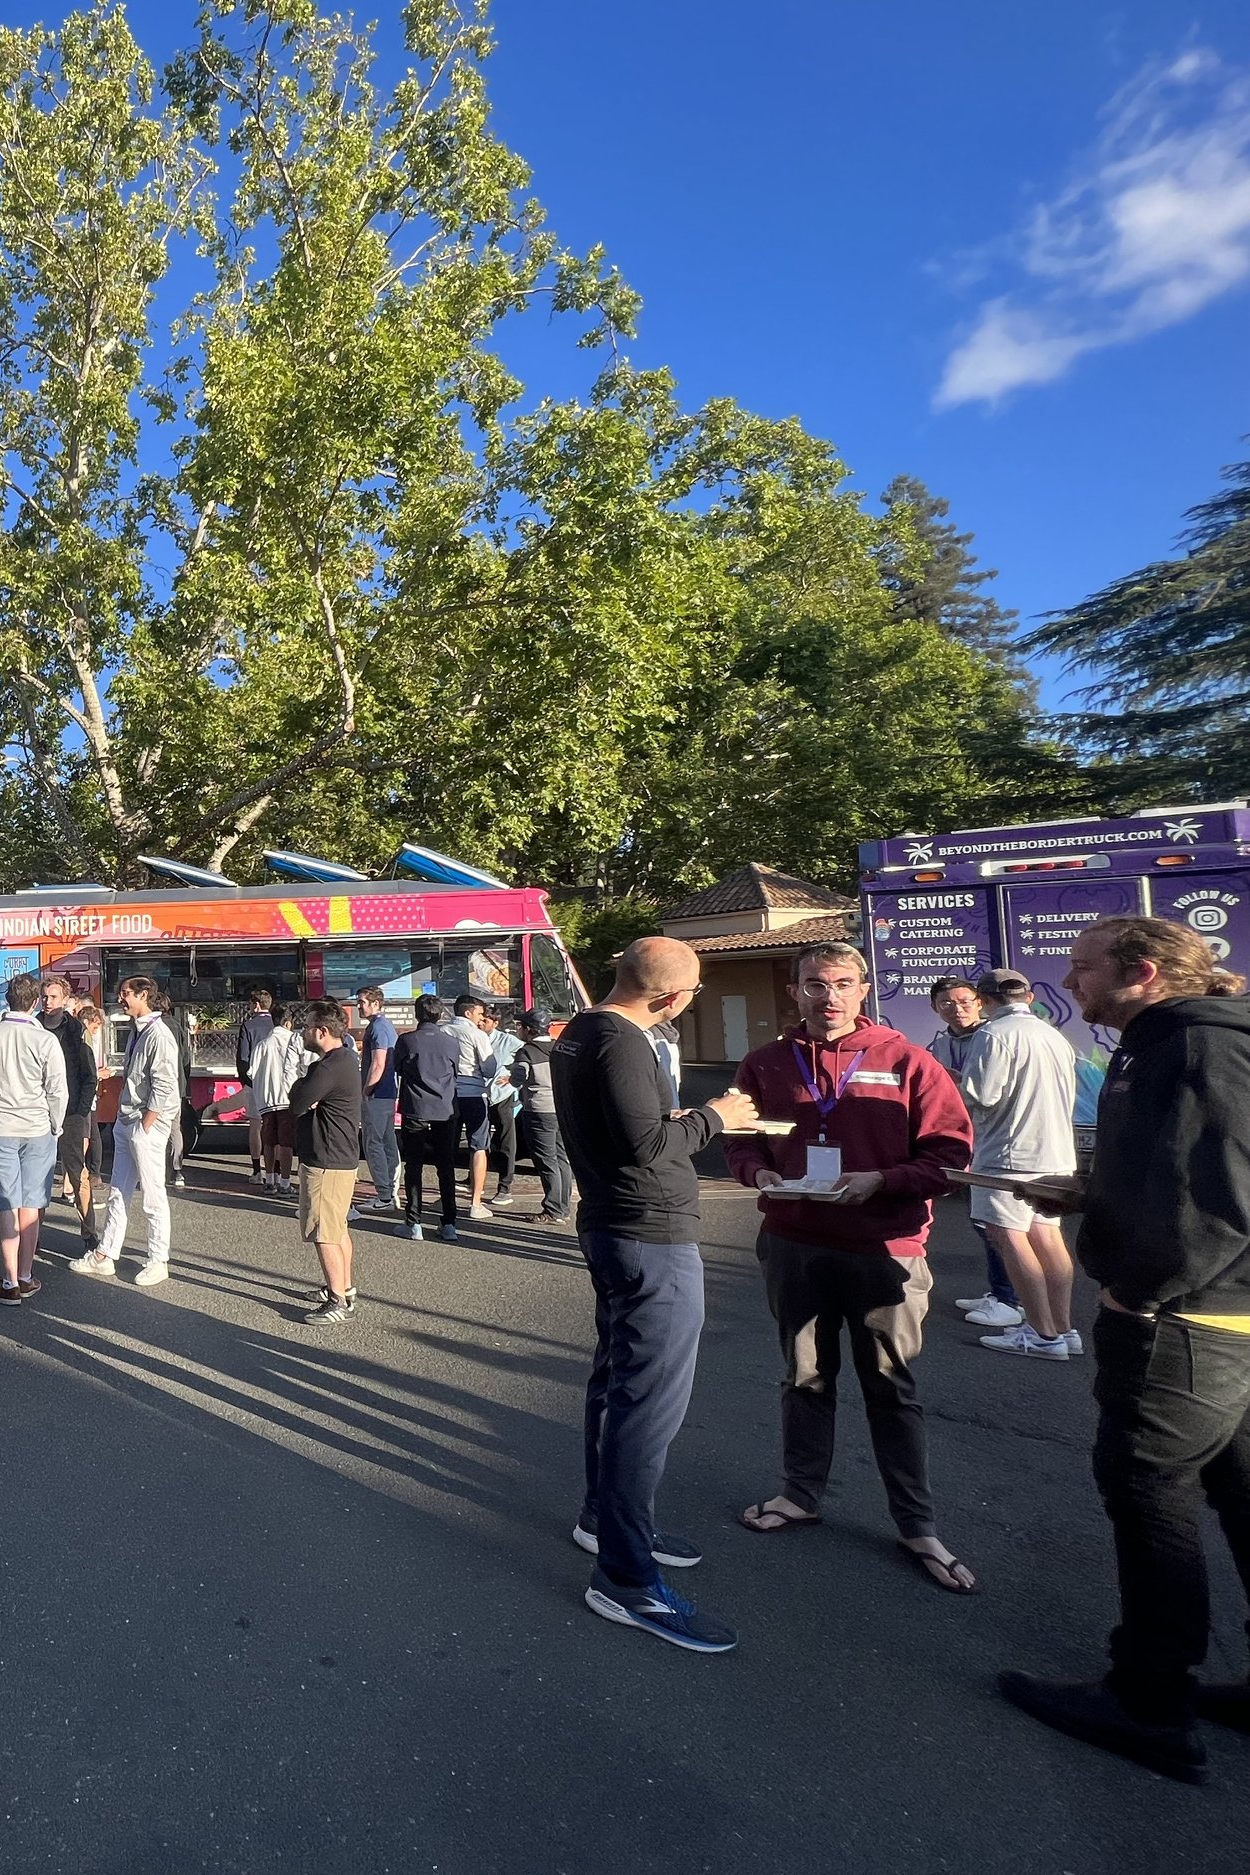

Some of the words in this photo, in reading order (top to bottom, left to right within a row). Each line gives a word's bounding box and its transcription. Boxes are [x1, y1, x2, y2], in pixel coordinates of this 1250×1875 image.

[937, 829, 1163, 857] BEYONDTHEBORDERTRUCK.COM
[897, 893, 975, 911] SERVICES
[1172, 890, 1220, 909] FOLLOW
[1221, 893, 1240, 906] US
[899, 917, 952, 928] CUSTOM
[1036, 912, 1100, 923] DELIVERY
[0, 915, 50, 938] INDIAN
[54, 915, 107, 936] STREET
[112, 914, 153, 935] FOOD
[899, 928, 964, 939] CATERING
[1037, 930, 1082, 939] FESTIV
[901, 945, 977, 956] CORPORATE
[901, 957, 976, 967] FUNCTIONS
[903, 987, 932, 996] MAR
